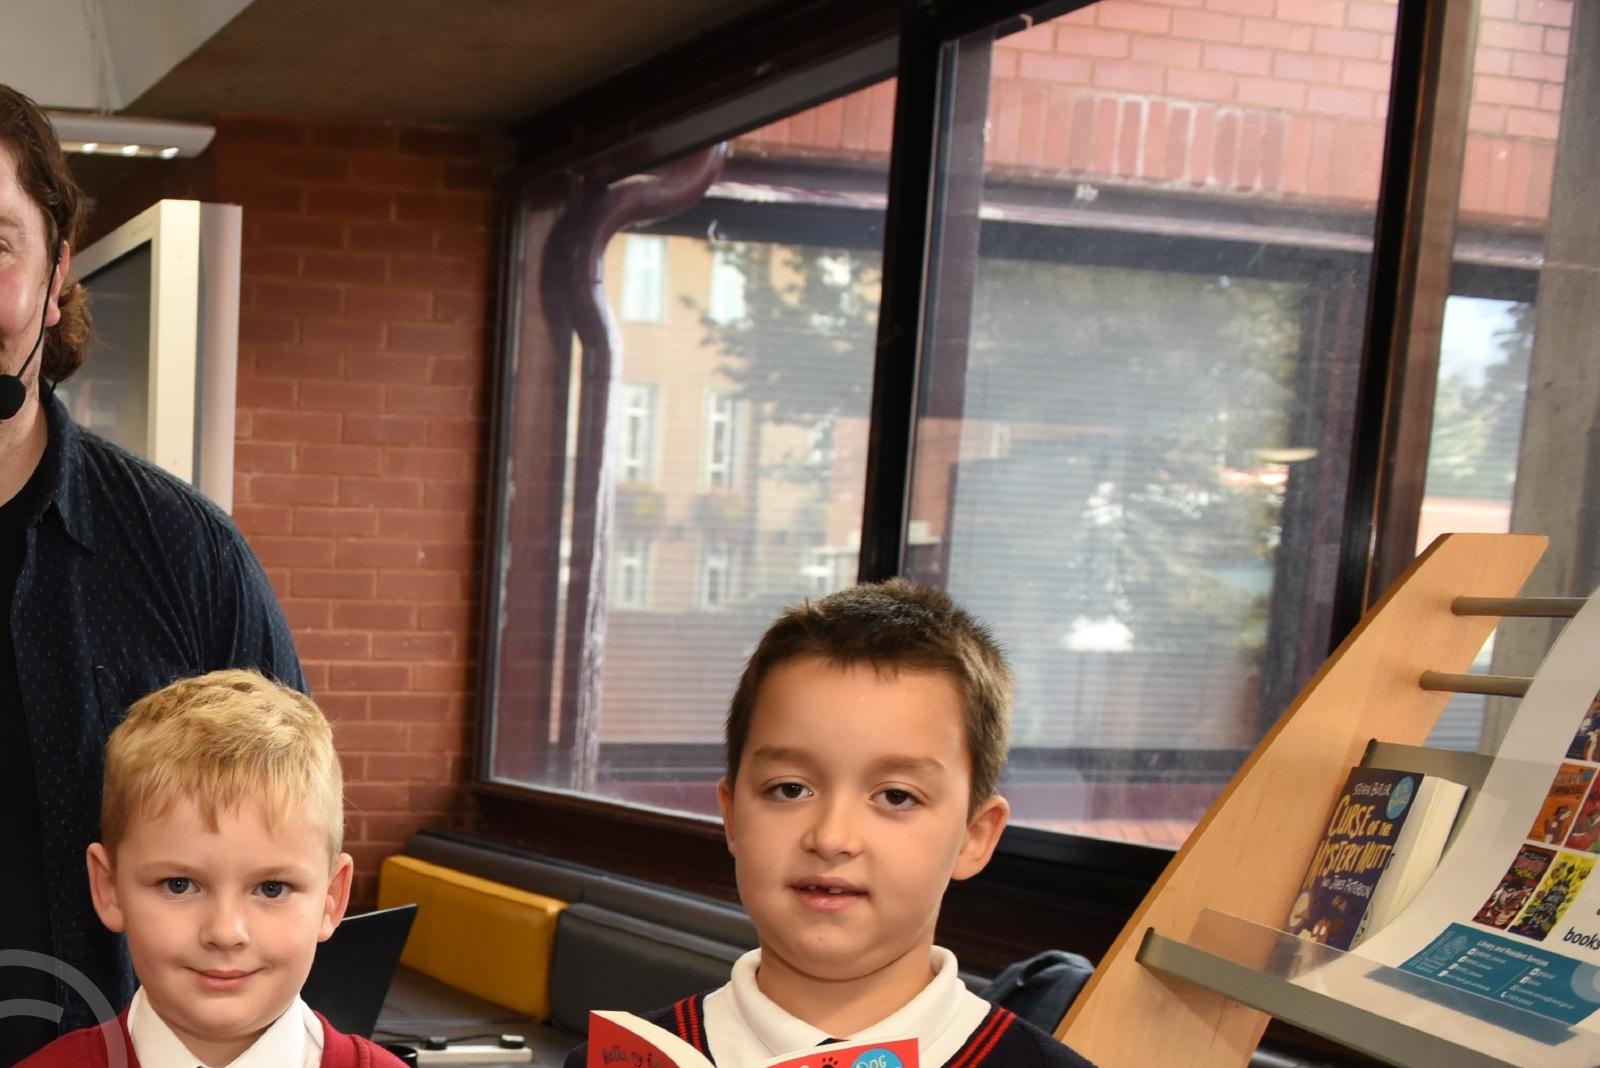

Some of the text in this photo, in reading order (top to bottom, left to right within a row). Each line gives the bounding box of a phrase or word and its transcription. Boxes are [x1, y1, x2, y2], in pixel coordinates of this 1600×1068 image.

[1328, 795, 1375, 838] CURSE
[1303, 838, 1365, 889] MYSTERY
[1564, 927, 1600, 950] books
